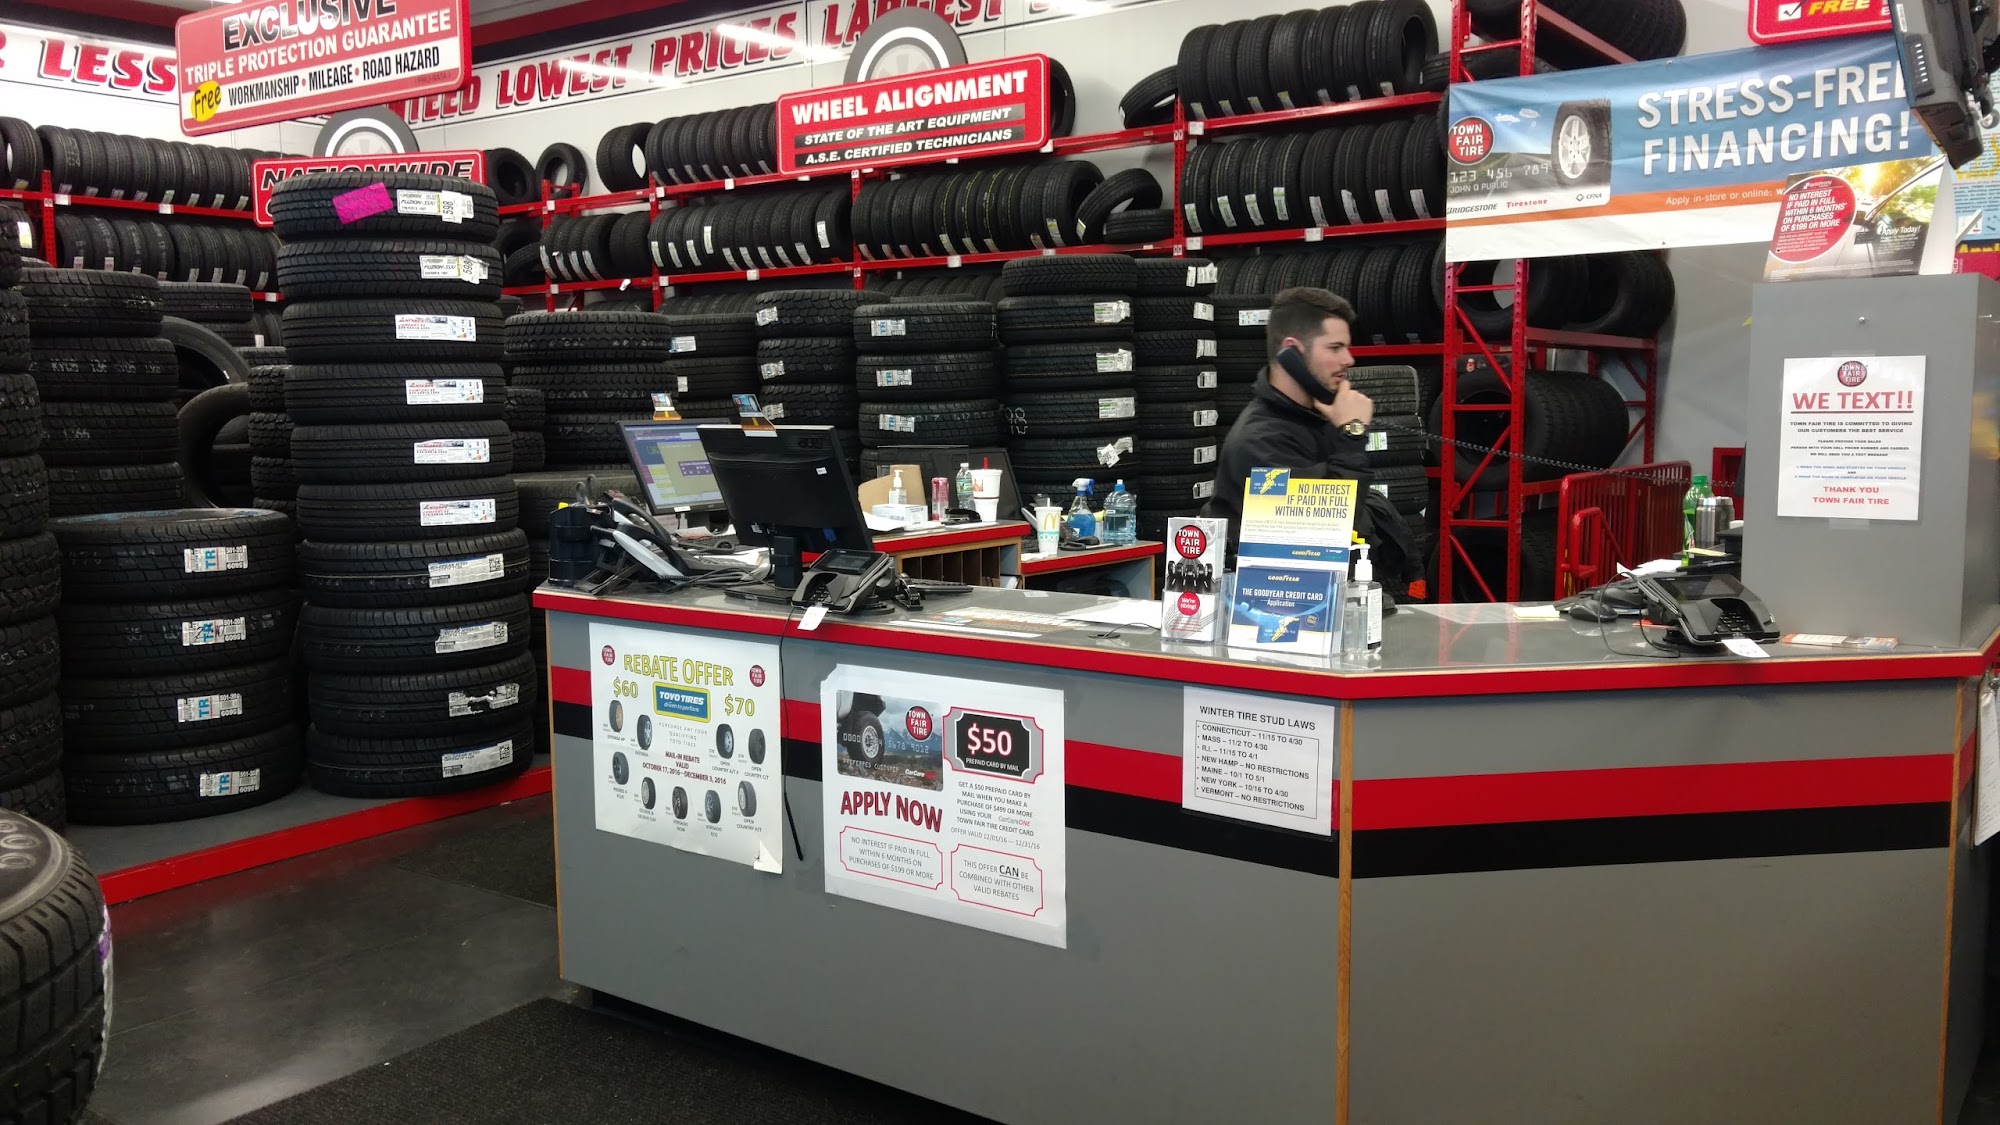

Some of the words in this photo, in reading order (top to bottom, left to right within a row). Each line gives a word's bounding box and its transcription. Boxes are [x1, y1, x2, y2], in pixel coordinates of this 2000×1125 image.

[1808, 0, 1870, 16] FREE
[185, 61, 234, 85] TRIPLE
[239, 34, 337, 71] PROTECTION
[342, 8, 451, 51] GUARANTEE
[652, 12, 797, 76] PRICES
[38, 38, 177, 94] LESS
[228, 75, 299, 106] WORKMANSHIP
[308, 64, 353, 91] MILEAGE
[362, 56, 391, 80] ROAD
[396, 46, 440, 74] HAZARD
[496, 44, 633, 109] LOWEST
[192, 83, 222, 120] Free
[792, 95, 868, 125] WHEEL
[874, 70, 1028, 114] ALIGNMENT
[804, 129, 843, 144] STATE
[846, 128, 864, 139] OF
[868, 123, 893, 137] THE
[896, 119, 923, 133] ART
[927, 107, 1012, 130] EQUIPMENT
[1452, 124, 1482, 136] TOWN
[805, 149, 841, 164] A.S.E.
[844, 141, 913, 159] CERTIFIED
[916, 129, 1012, 152] TECHNICIANS
[1456, 135, 1483, 146] FAIR
[1644, 111, 1910, 176] FINANCING!
[1459, 145, 1484, 156] TIRE
[1449, 171, 1477, 184] 123
[1524, 163, 1549, 176] 789
[1449, 182, 1471, 194] JOHN
[1474, 182, 1479, 192] Q
[1481, 180, 1508, 191] PUBLIC
[1800, 189, 1832, 200] INTEREST
[1507, 198, 1548, 209] Firestone
[1666, 195, 1690, 206] Apply
[1693, 191, 1726, 202] in-store
[1742, 188, 1772, 198] online:
[1794, 200, 1809, 208] PAID
[1820, 197, 1836, 205] FULL
[442, 200, 454, 217] 598
[1447, 202, 1498, 214] BRIDGESTONE
[1785, 208, 1808, 216] WITHIN
[1794, 212, 1834, 223] PURCHASES
[1809, 221, 1819, 229] OR
[1820, 219, 1840, 227] MORE
[1882, 226, 1899, 236] Apply
[1901, 225, 1921, 234] Today!
[1793, 392, 1830, 409] WE
[1837, 391, 1913, 409] TEXT!!
[1298, 483, 1310, 495] NO
[1312, 484, 1351, 495] INTEREST
[1287, 495, 1295, 505] IF
[1297, 495, 1317, 506] PAID
[1318, 496, 1327, 506] IN
[1329, 496, 1349, 507] FULL
[1275, 506, 1304, 517] WITHIN
[1306, 507, 1311, 517] 6
[1313, 507, 1347, 519] MONTHS
[1178, 529, 1199, 538] TOWN
[1181, 538, 1200, 546] FAIR
[1182, 546, 1200, 555] TIRE
[205, 550, 216, 570] TR
[1242, 588, 1252, 596] THE
[1254, 589, 1284, 599] GOODYEAR
[1285, 591, 1305, 600] CREDIT
[1307, 592, 1323, 601] CARD
[1267, 599, 1295, 608] Application
[624, 654, 679, 682] REBATE
[683, 659, 734, 686] OFFER
[613, 676, 638, 698] $60
[660, 691, 681, 700] TOYO
[681, 694, 704, 705] TIRES
[725, 694, 755, 716] $70
[199, 698, 209, 718] TR
[909, 711, 926, 719] TOWN
[911, 719, 926, 727] FAIR
[1200, 705, 1235, 719] WINTER
[1237, 711, 1257, 722] TIRE
[1260, 715, 1285, 726] STUD
[1287, 719, 1316, 731] LAWS
[913, 727, 927, 735] TIRE
[967, 723, 1012, 756] $50
[1202, 724, 1250, 737] CONNECTICUT
[1258, 733, 1275, 742] 11/15
[1289, 738, 1303, 746] 4/30
[1202, 734, 1221, 744] MASS
[1228, 738, 1242, 747] 11/2
[1243, 740, 1253, 748] TO
[1254, 743, 1268, 751] 4/30
[665, 751, 682, 760] MAIL-IN
[683, 755, 700, 763] REBATE
[966, 758, 985, 766] PREPAID
[1202, 755, 1217, 764] NEW
[1219, 758, 1239, 767] HAMP
[1246, 763, 1256, 771] NO
[1258, 765, 1309, 780] RESTRICTIONS
[219, 773, 230, 794] TR
[1201, 776, 1216, 785] NEW
[1218, 779, 1237, 789] YORK
[1245, 784, 1262, 793] 10/16
[1275, 789, 1288, 798] 4/30
[1201, 787, 1234, 798] VERMONT
[1241, 794, 1251, 802] NO
[1253, 796, 1305, 811] RESTRICTIONS
[841, 791, 891, 816] APPLY
[895, 795, 943, 833] NOW
[964, 860, 977, 869] THIS
[978, 862, 998, 872] OFFER
[999, 864, 1019, 877] CAN
[1021, 871, 1029, 880] BE
